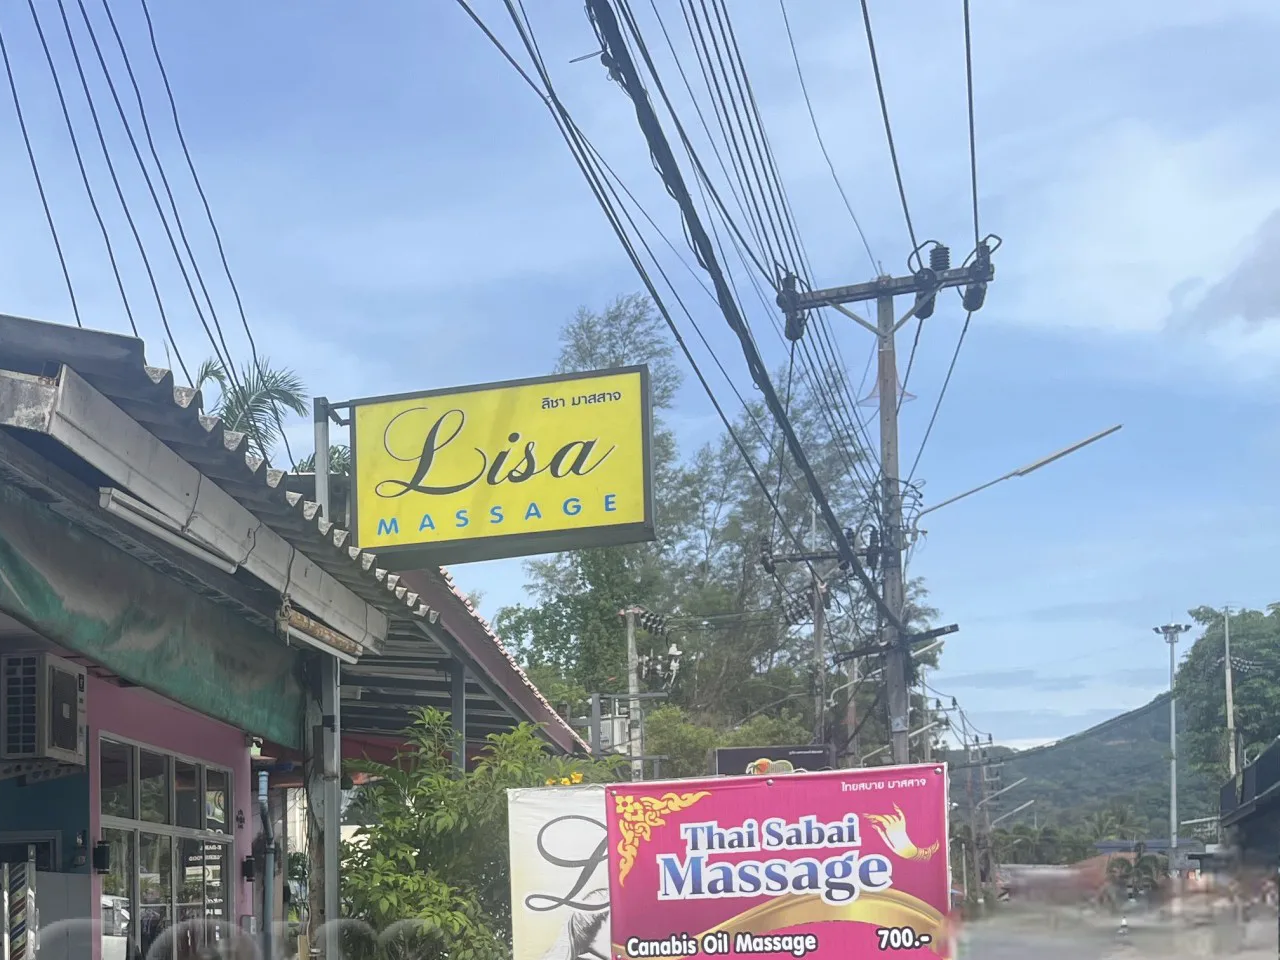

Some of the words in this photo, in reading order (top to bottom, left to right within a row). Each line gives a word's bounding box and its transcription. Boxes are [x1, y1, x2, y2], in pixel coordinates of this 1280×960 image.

[571, 391, 622, 406] มาสสาจ
[374, 407, 616, 498] Lisa
[377, 493, 617, 536] MASSAGE
[840, 781, 885, 792] ไทยสบาย
[887, 778, 927, 790] มาสสาจ
[683, 822, 757, 851] Thai
[764, 816, 857, 847] Sabai
[661, 854, 888, 902] Massage
[626, 933, 700, 957] Canabis
[702, 933, 729, 955] Oil
[734, 932, 817, 957] Massage
[876, 927, 931, 950] 700.-
